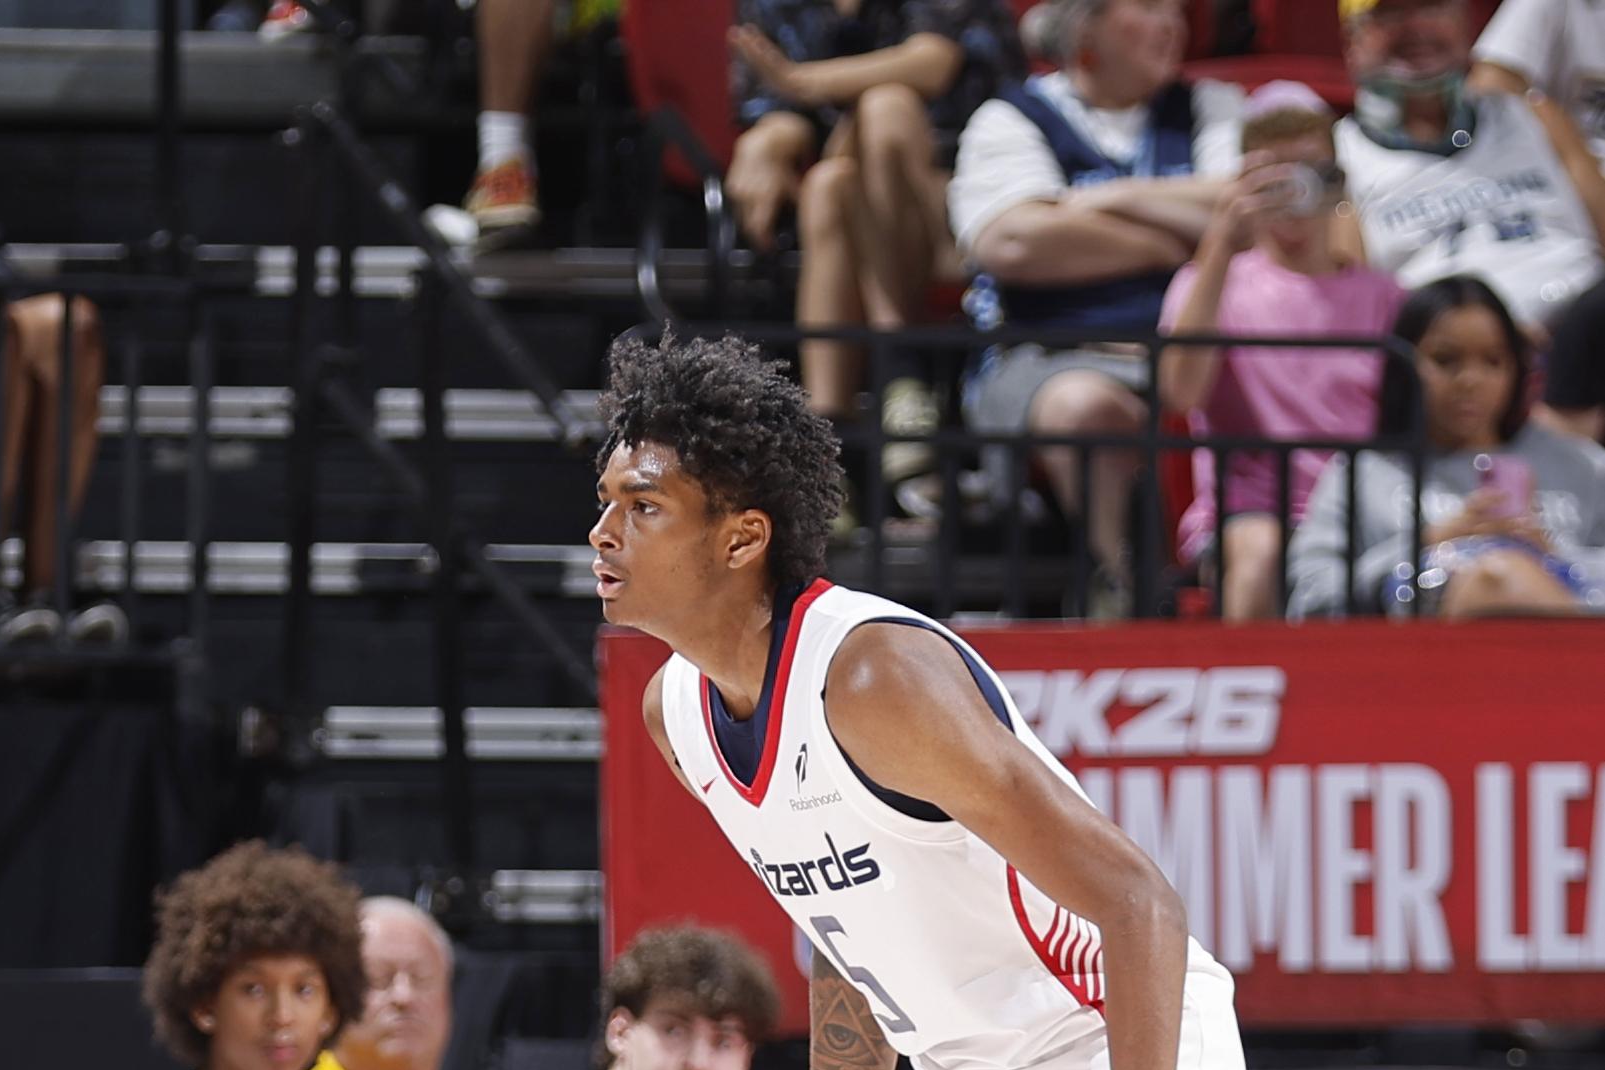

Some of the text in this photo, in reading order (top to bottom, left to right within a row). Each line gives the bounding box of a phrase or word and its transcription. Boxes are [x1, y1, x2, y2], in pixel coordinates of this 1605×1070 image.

[789, 789, 843, 812] Robinhood
[749, 831, 881, 897] izards
[1475, 762, 1605, 973] LE
